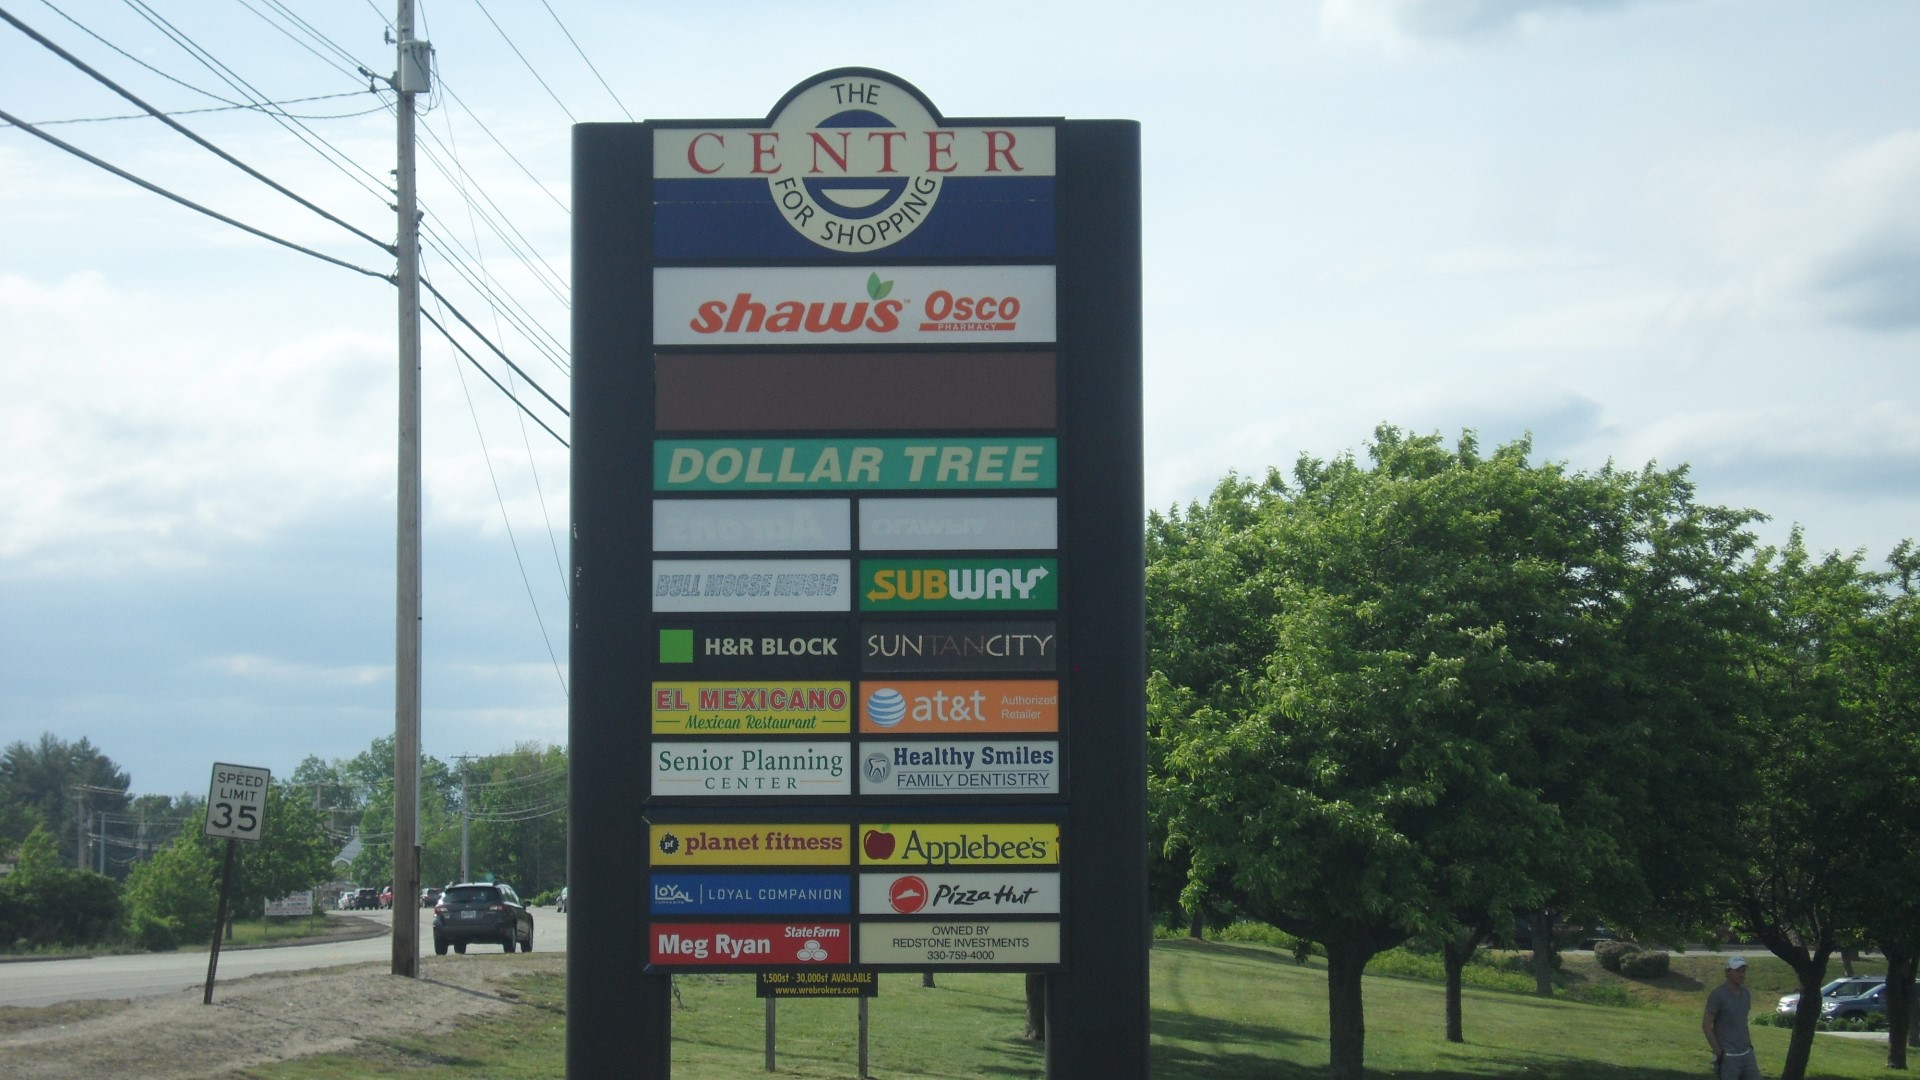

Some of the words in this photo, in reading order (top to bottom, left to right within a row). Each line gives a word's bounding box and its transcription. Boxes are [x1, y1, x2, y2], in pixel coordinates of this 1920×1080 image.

[830, 83, 881, 106] THE
[687, 130, 1024, 174] CENTER
[775, 176, 815, 228] FOR
[820, 175, 936, 246] SHOPPING
[925, 290, 1021, 321] Osco
[938, 323, 997, 332] PHARMACY
[667, 446, 884, 484] DOLLAR
[904, 446, 1044, 482] TREE
[655, 574, 701, 597] BULL
[704, 574, 773, 597] MOOSE
[774, 573, 839, 597] MUSIC
[866, 565, 1049, 602] SUBWAY
[705, 638, 754, 656] H&R
[761, 638, 838, 656] BLOCK
[655, 688, 689, 711] EL
[699, 687, 847, 712] MEXICANO
[911, 690, 986, 722] at&t
[1001, 695, 1056, 705] Authorized
[685, 715, 741, 729] Mexican
[746, 714, 817, 729] Restaurant
[1001, 709, 1041, 719] Retailer
[658, 749, 733, 771] Senior
[741, 749, 843, 777] Planning
[893, 747, 974, 769] Healthy
[981, 747, 1054, 765] Smiles
[217, 772, 263, 788] SPEED
[704, 777, 797, 790] CENTER
[897, 774, 953, 787] FAMILY
[958, 773, 1049, 786] DENTISTRY
[220, 788, 257, 801] LIMIT
[211, 803, 257, 832] 35
[685, 832, 760, 855] planet
[765, 832, 843, 850] fitness
[901, 830, 1047, 865] Applebee's
[708, 889, 752, 900] LOYAL
[758, 889, 842, 900] COMPANION
[932, 884, 991, 906] Pizza
[993, 884, 1039, 905] Hut
[932, 926, 973, 935] OWNED
[976, 926, 990, 935] BY
[658, 934, 708, 958] Meg
[715, 934, 771, 958] Ryan
[892, 938, 951, 948] REDSTONE
[954, 938, 1029, 948] INVESTMENTS
[927, 950, 995, 960] 330-759-4000
[831, 973, 872, 983] AVAILABLE
[775, 986, 859, 995] www.wrebrokers.com
